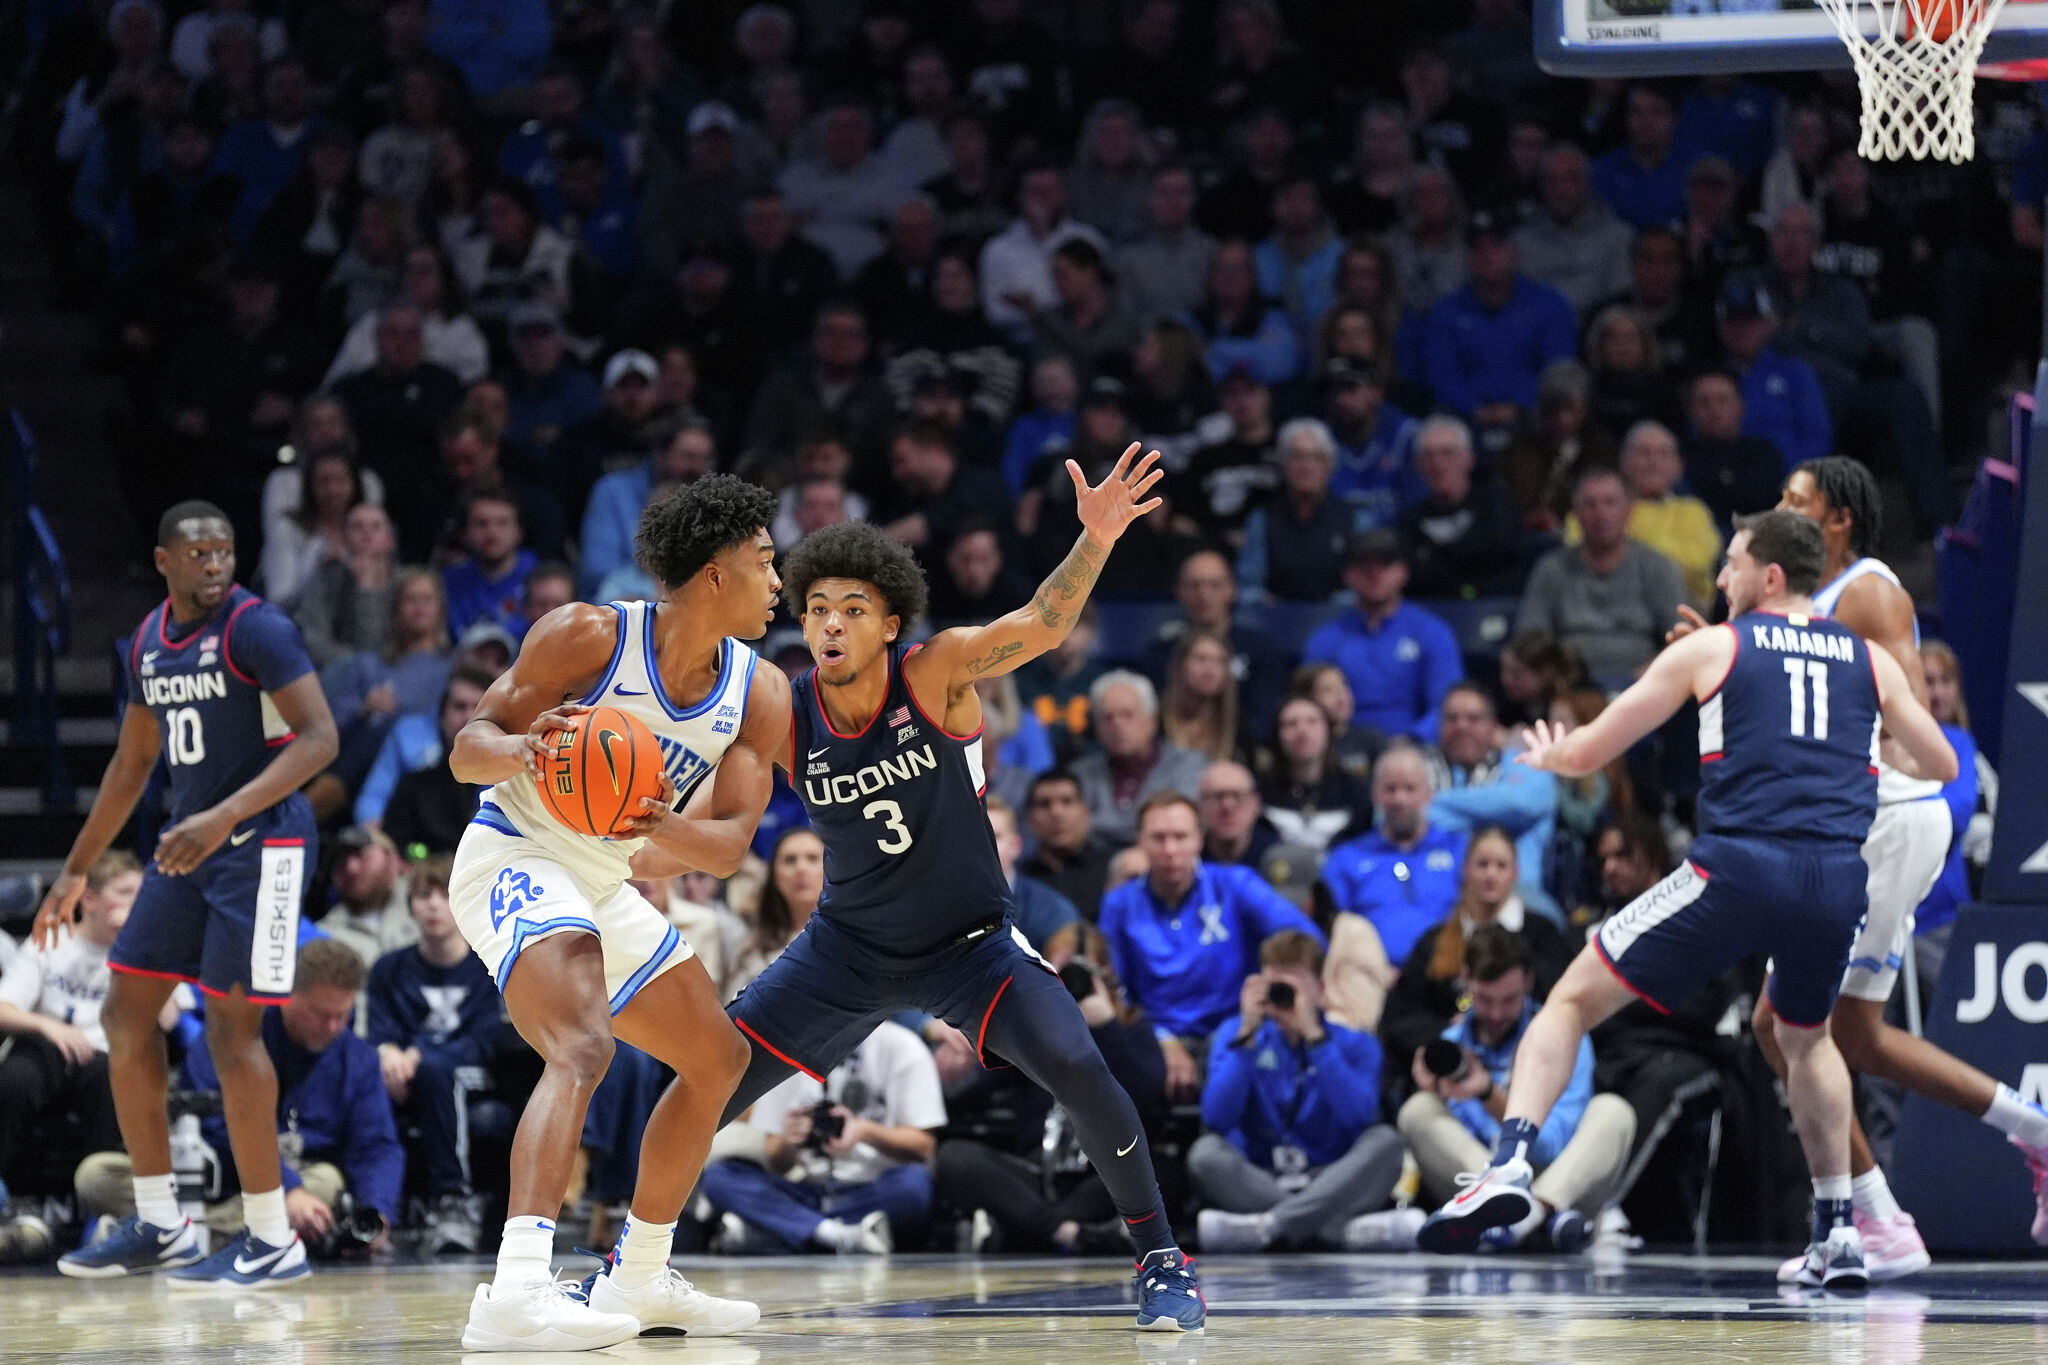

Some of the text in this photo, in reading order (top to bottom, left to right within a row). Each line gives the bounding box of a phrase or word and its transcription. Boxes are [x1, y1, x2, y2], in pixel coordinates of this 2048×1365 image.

[1752, 624, 1855, 664] KARABAN
[142, 670, 228, 707] UCONN
[1783, 656, 1829, 741] 11
[166, 706, 206, 766] 10
[711, 725, 734, 735] CHANGE
[724, 721, 734, 729] THE
[897, 724, 913, 736] BIG
[897, 727, 920, 742] EAST
[556, 731, 577, 795] ELITE
[804, 743, 938, 806] UCONN
[806, 767, 831, 776] CHANGE
[816, 761, 829, 769] THE
[862, 799, 913, 855] 3
[269, 856, 292, 983] HUSKIES
[1608, 867, 1694, 940] HUSKIES
